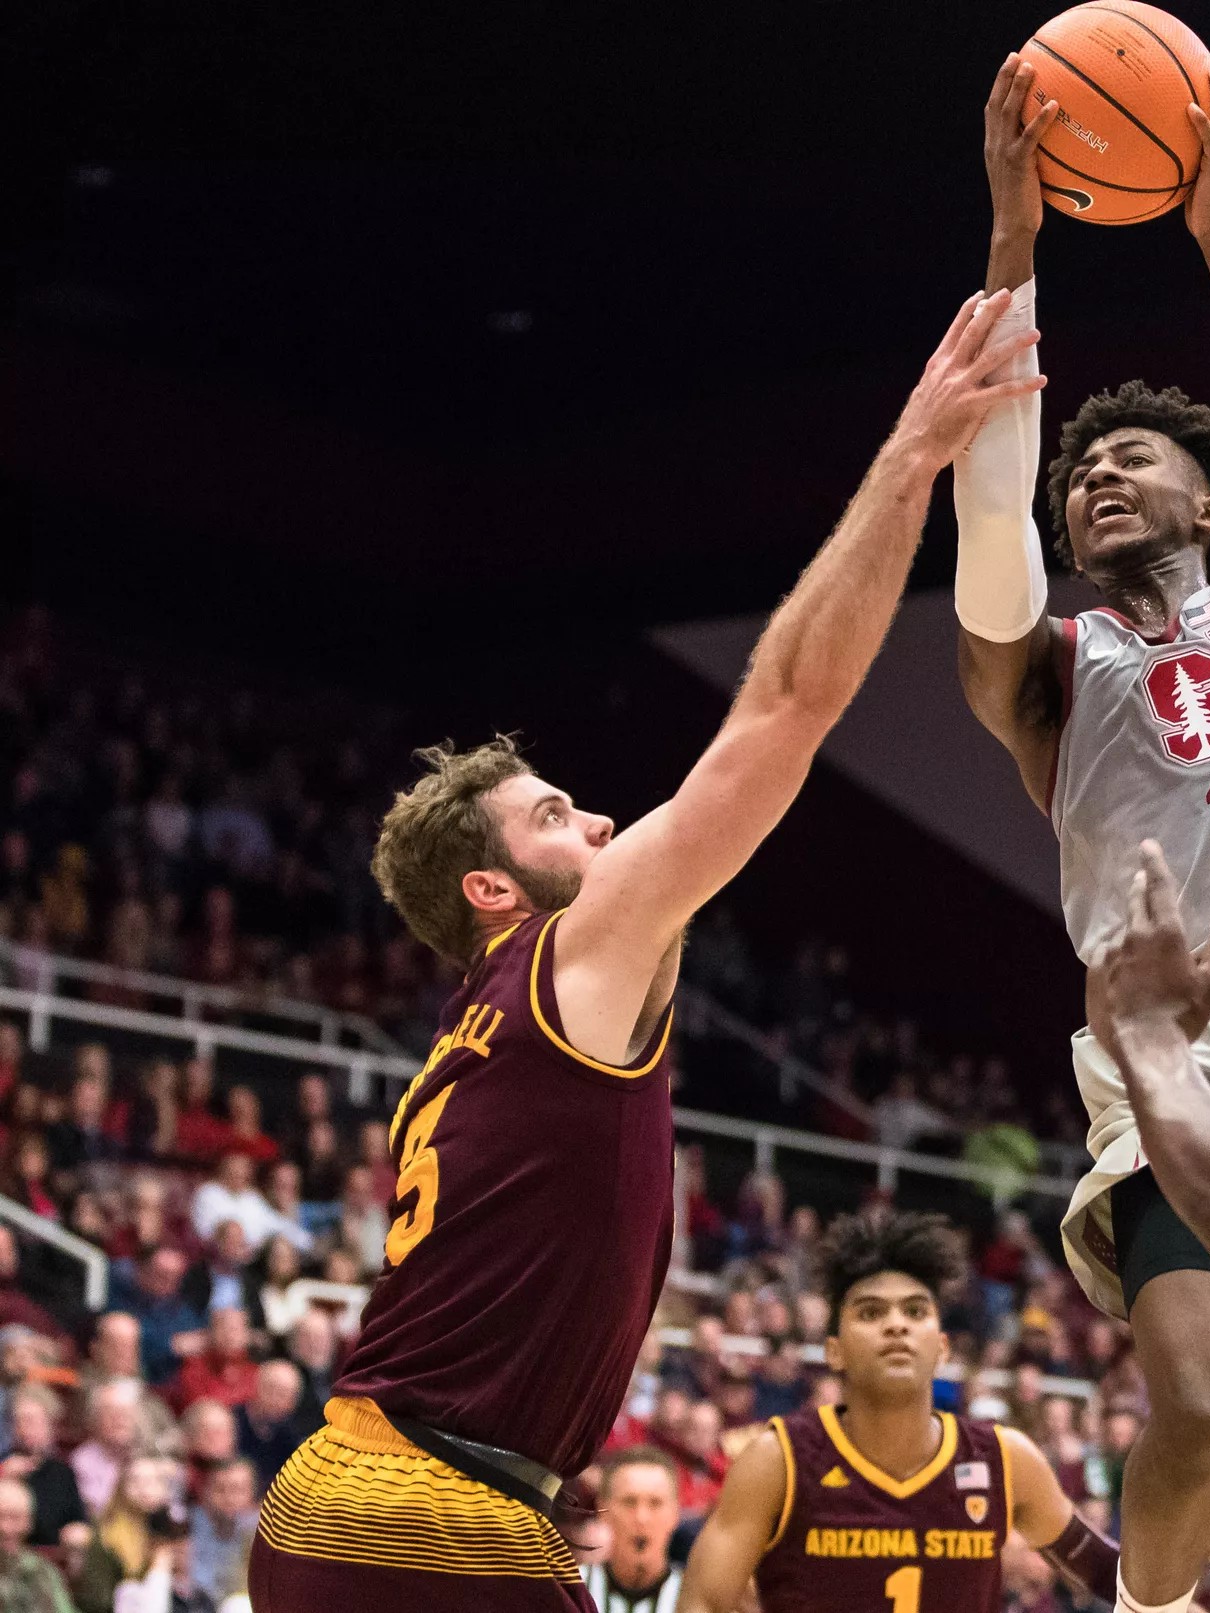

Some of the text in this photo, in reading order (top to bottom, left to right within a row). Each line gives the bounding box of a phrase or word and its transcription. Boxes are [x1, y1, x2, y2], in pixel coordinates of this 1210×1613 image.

[1034, 88, 1109, 153] HYPERETE
[805, 1527, 997, 1559] ARIZONA STATE
[884, 1564, 924, 1613] 1
